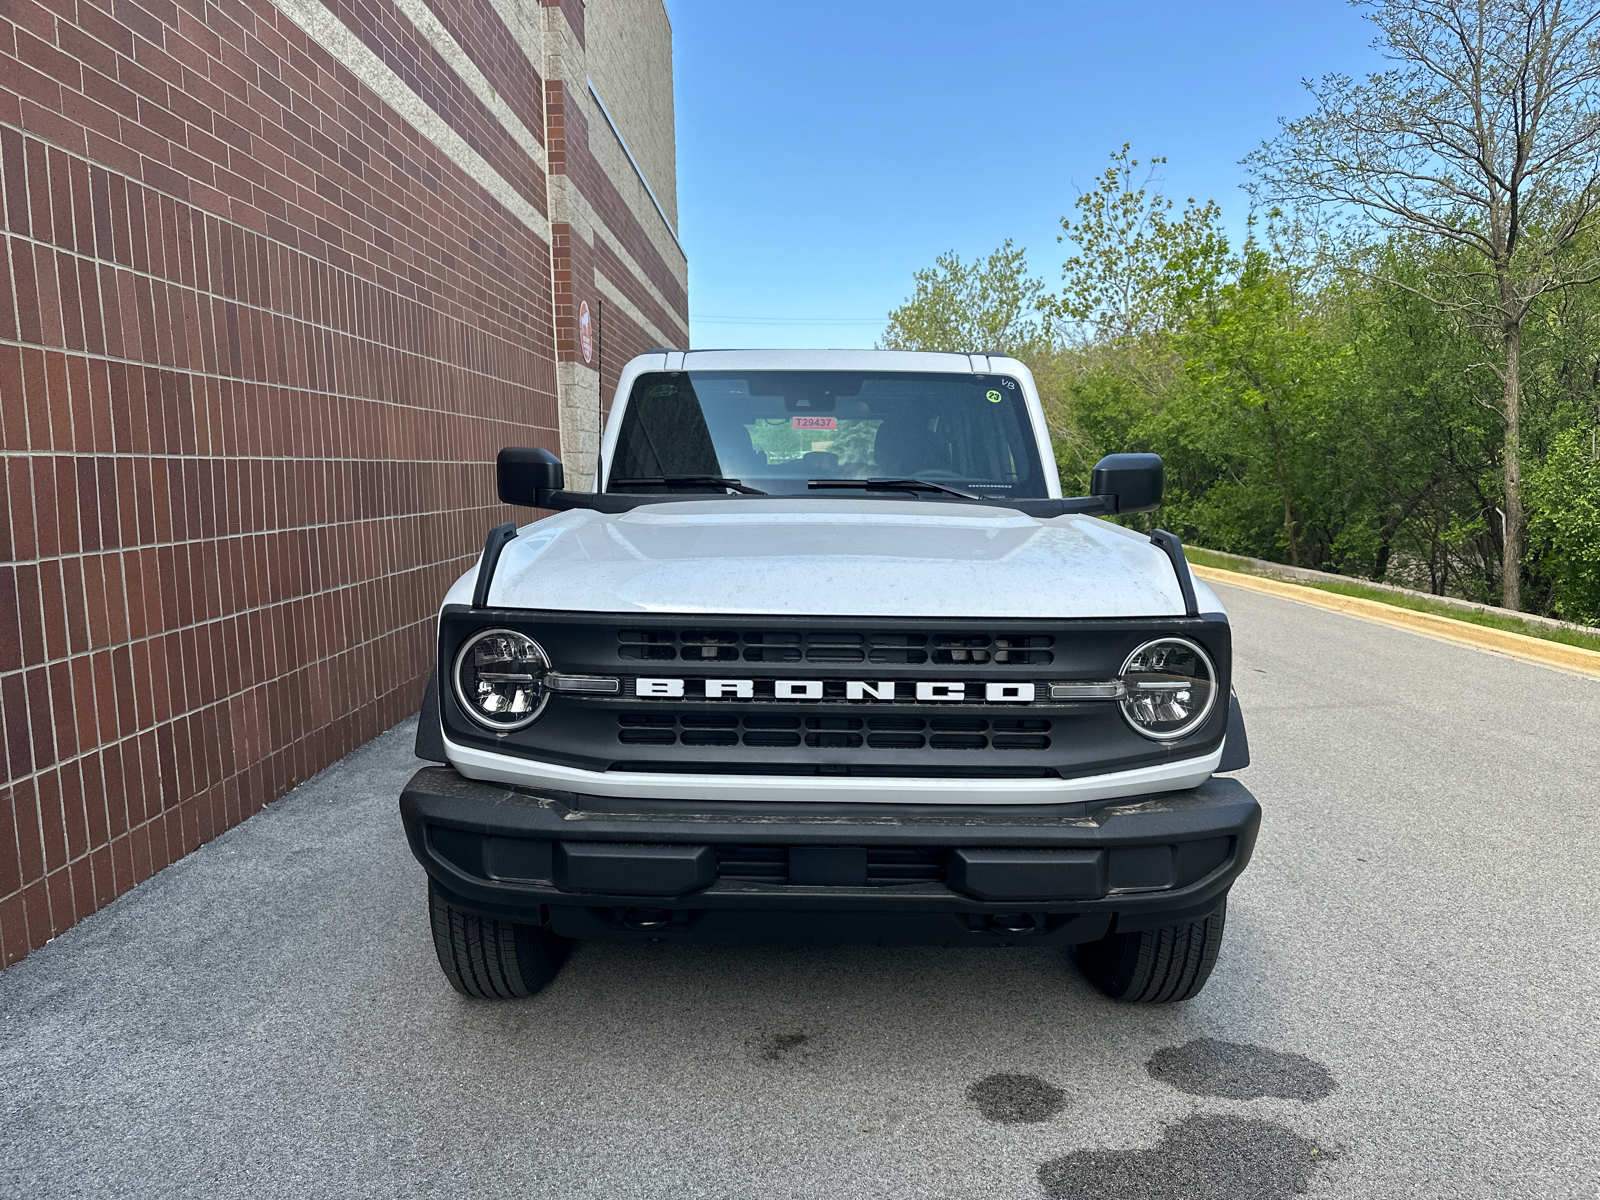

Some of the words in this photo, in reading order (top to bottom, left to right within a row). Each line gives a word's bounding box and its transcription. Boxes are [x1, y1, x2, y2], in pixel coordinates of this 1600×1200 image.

[988, 391, 1000, 401] 23
[795, 418, 831, 427] T29437
[636, 678, 1035, 702] BRONCO
